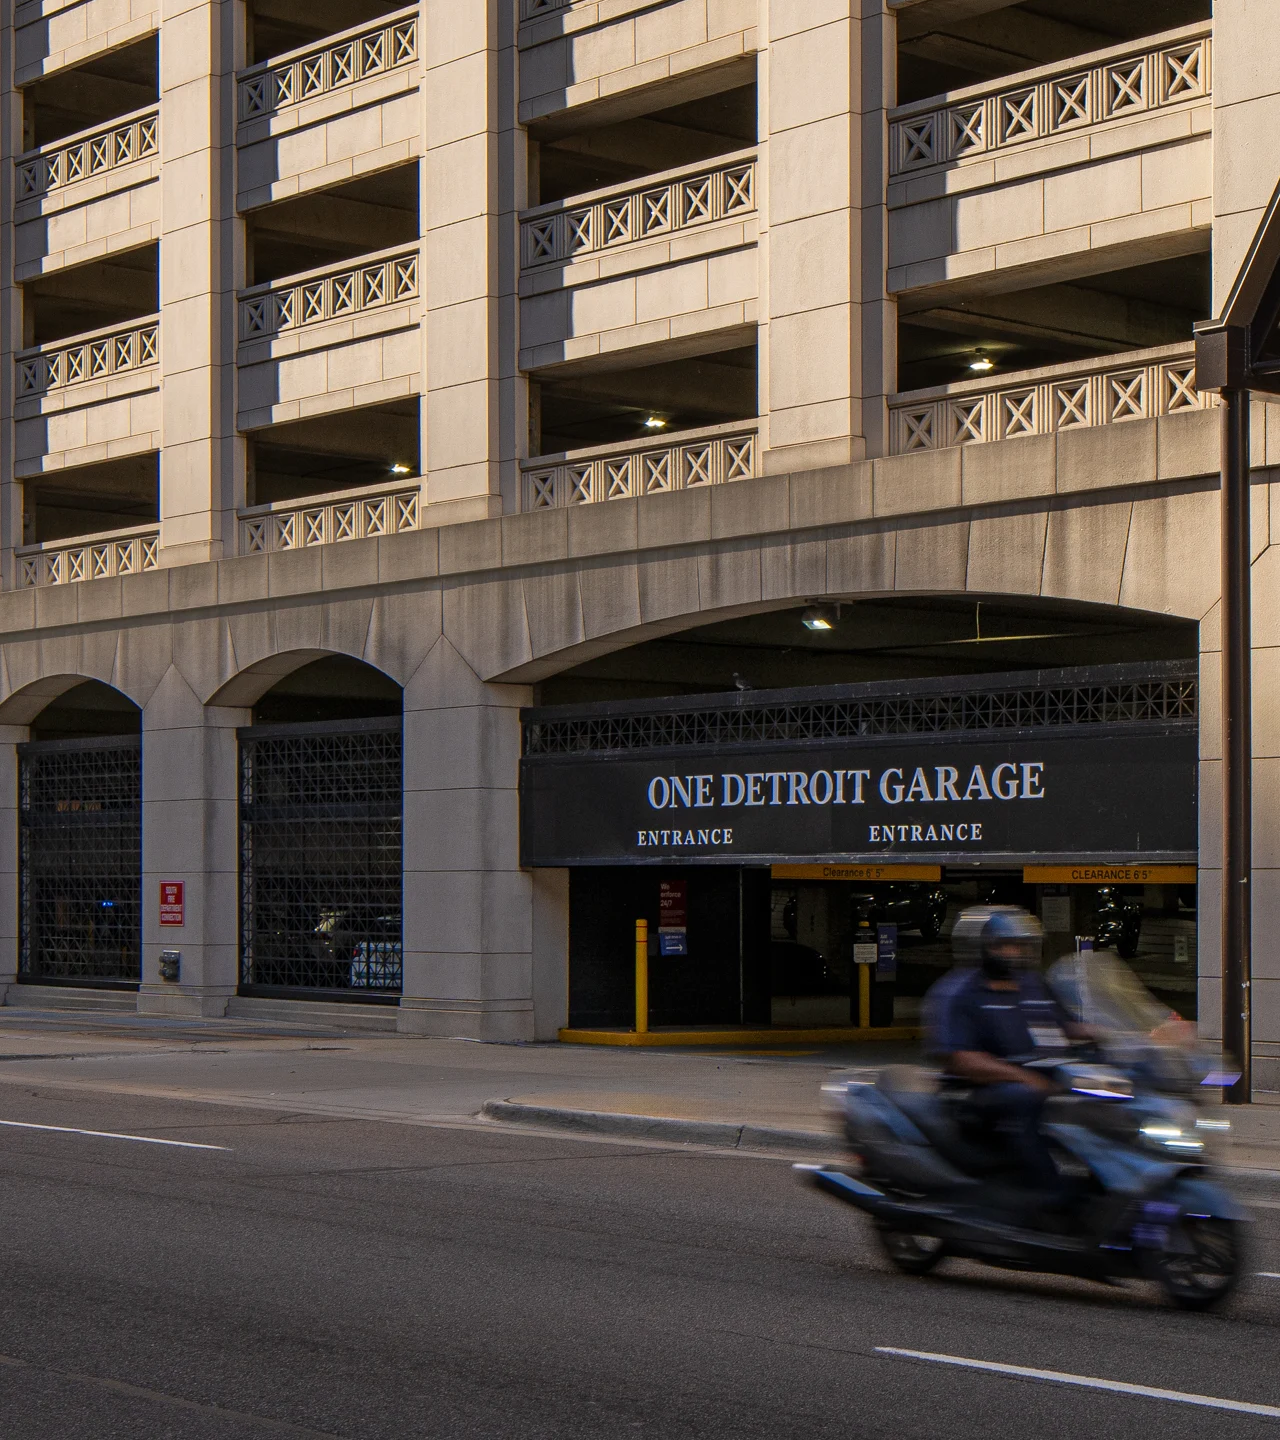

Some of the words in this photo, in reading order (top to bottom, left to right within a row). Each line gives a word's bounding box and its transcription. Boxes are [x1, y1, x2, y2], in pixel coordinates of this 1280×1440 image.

[647, 774, 715, 810] ONE
[721, 769, 871, 807] DETROIT
[878, 762, 1046, 805] GARAGE
[637, 827, 734, 846] ENTRANCE
[868, 823, 983, 842] ENTRANCE
[823, 867, 865, 878] Clearance
[1071, 869, 1131, 880] CLEARANCE
[660, 899, 672, 907] 24/7
